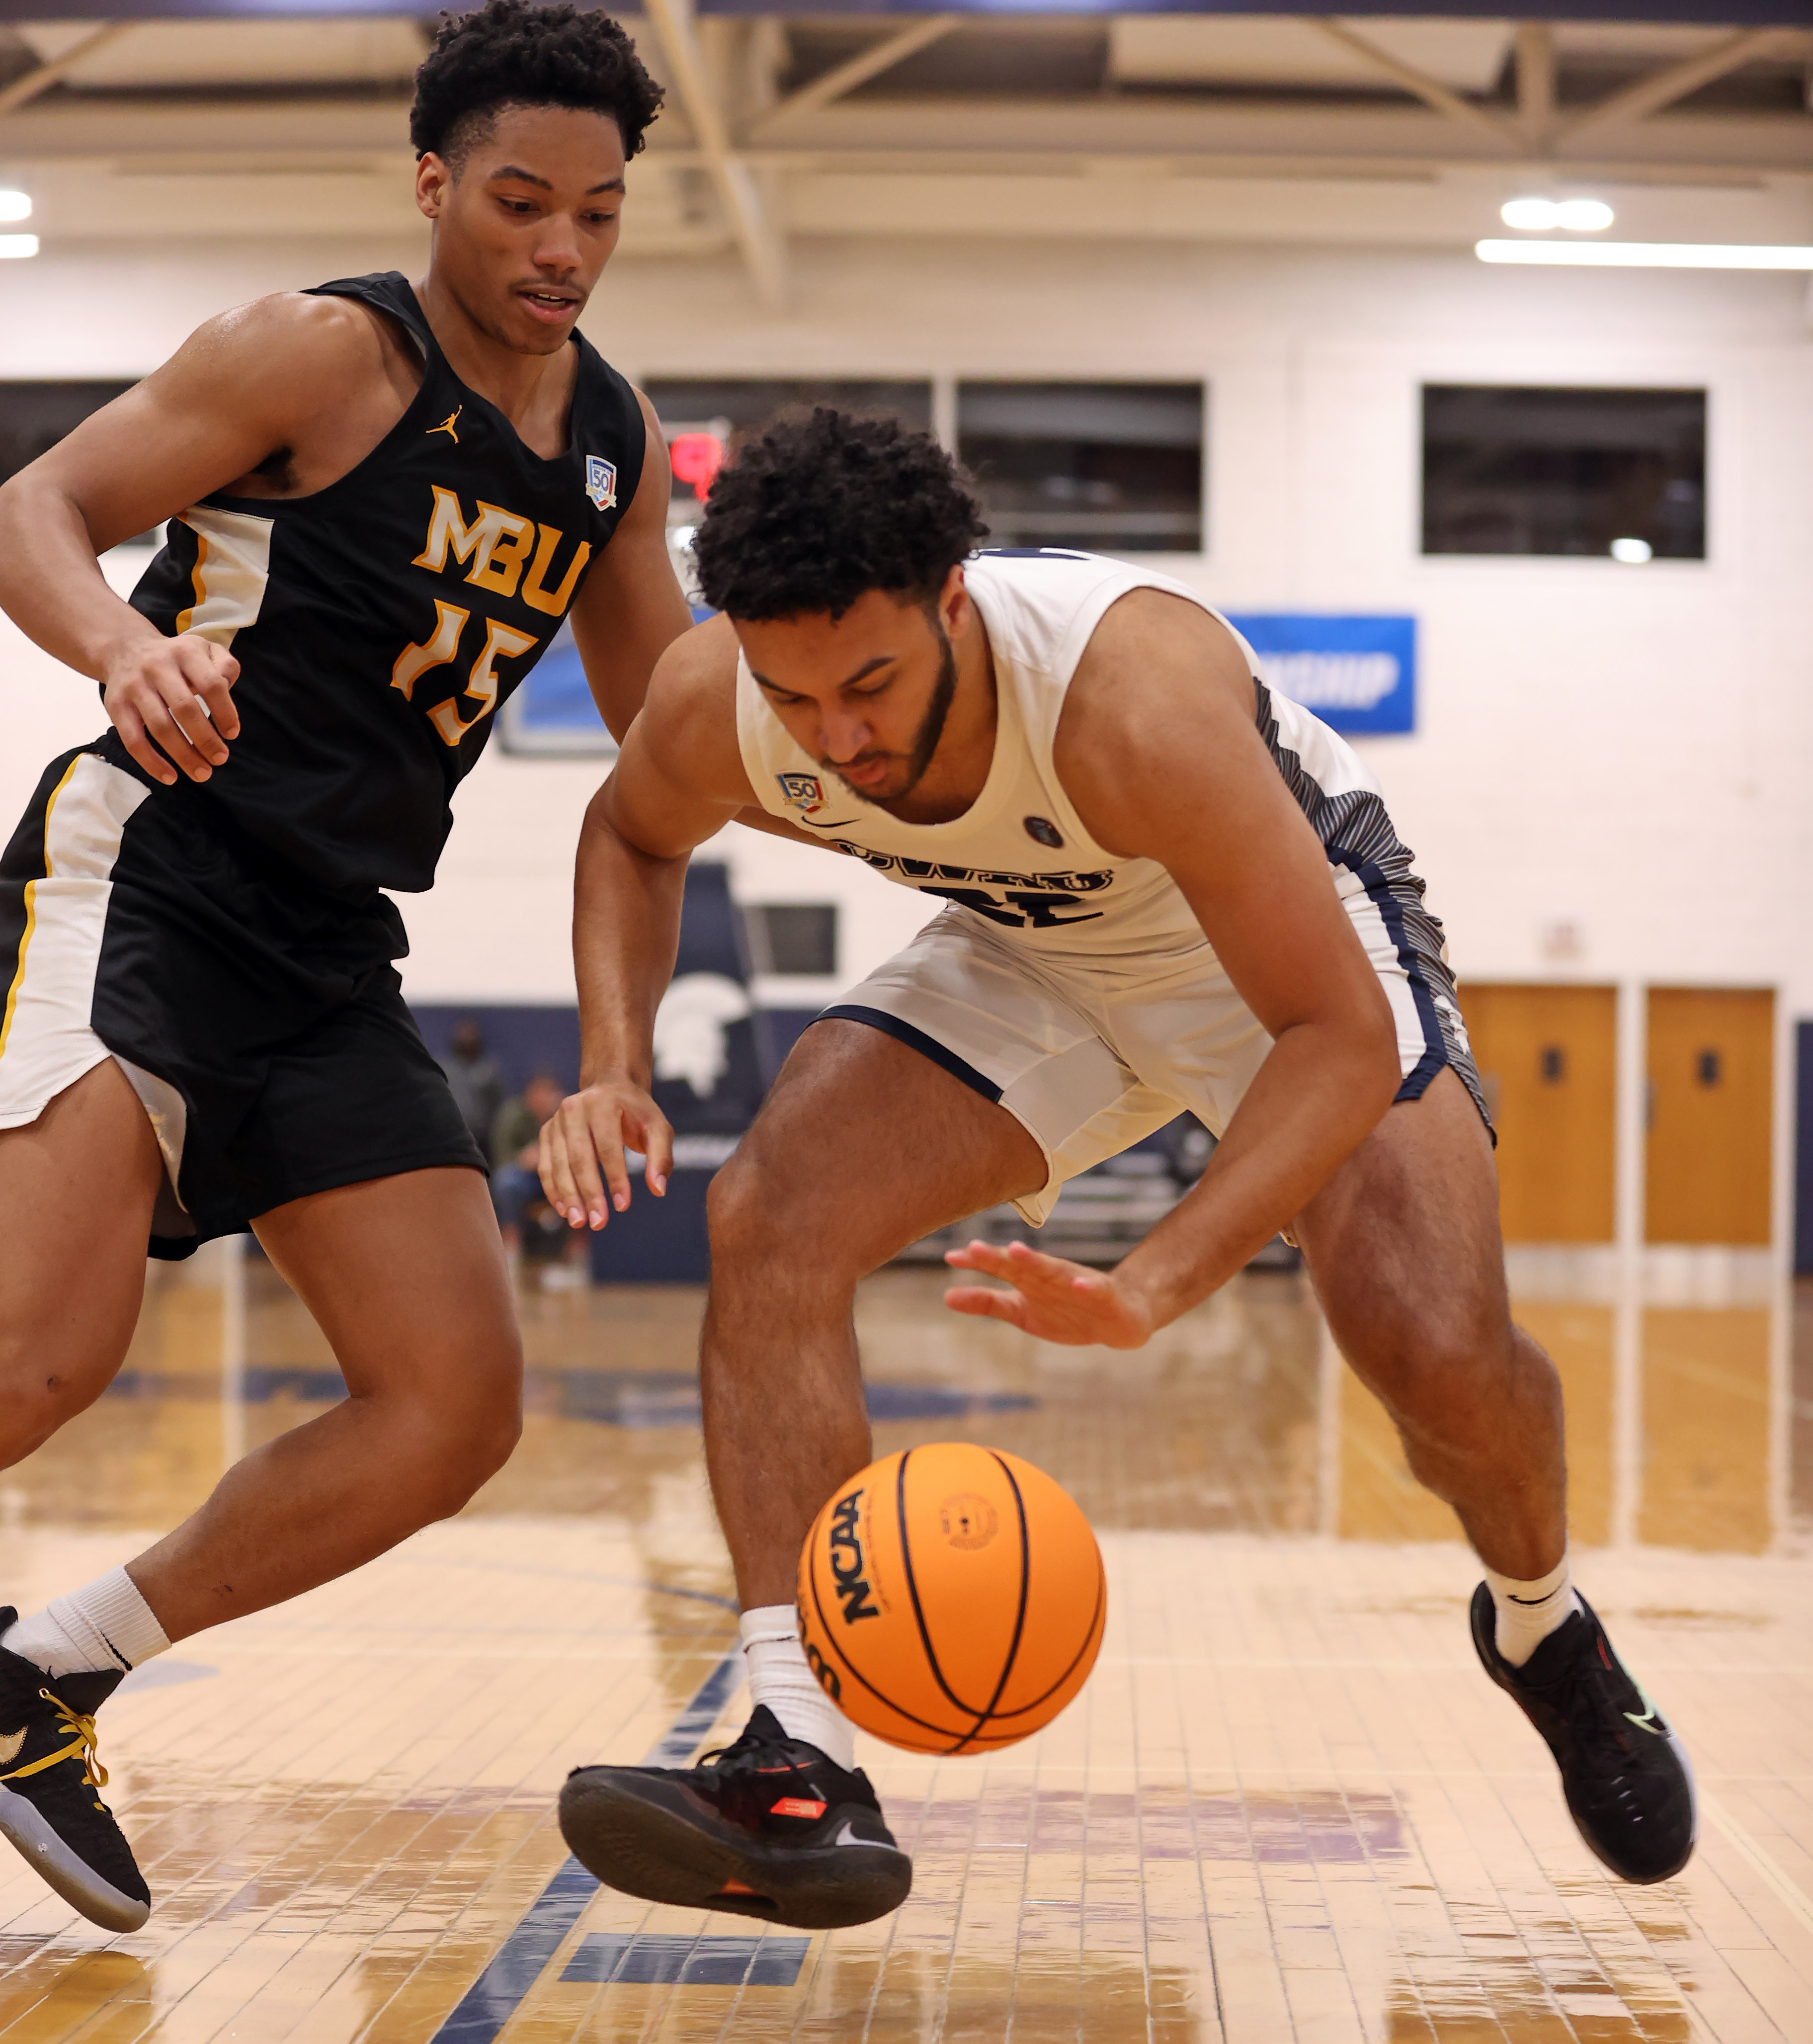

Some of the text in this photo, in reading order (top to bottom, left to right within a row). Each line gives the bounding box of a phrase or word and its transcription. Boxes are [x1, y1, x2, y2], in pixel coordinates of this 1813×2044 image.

[593, 469, 609, 492] 50
[411, 484, 592, 617] MBU
[390, 598, 539, 746] 15
[788, 782, 817, 798] 50
[830, 1489, 880, 1624] NCAA
